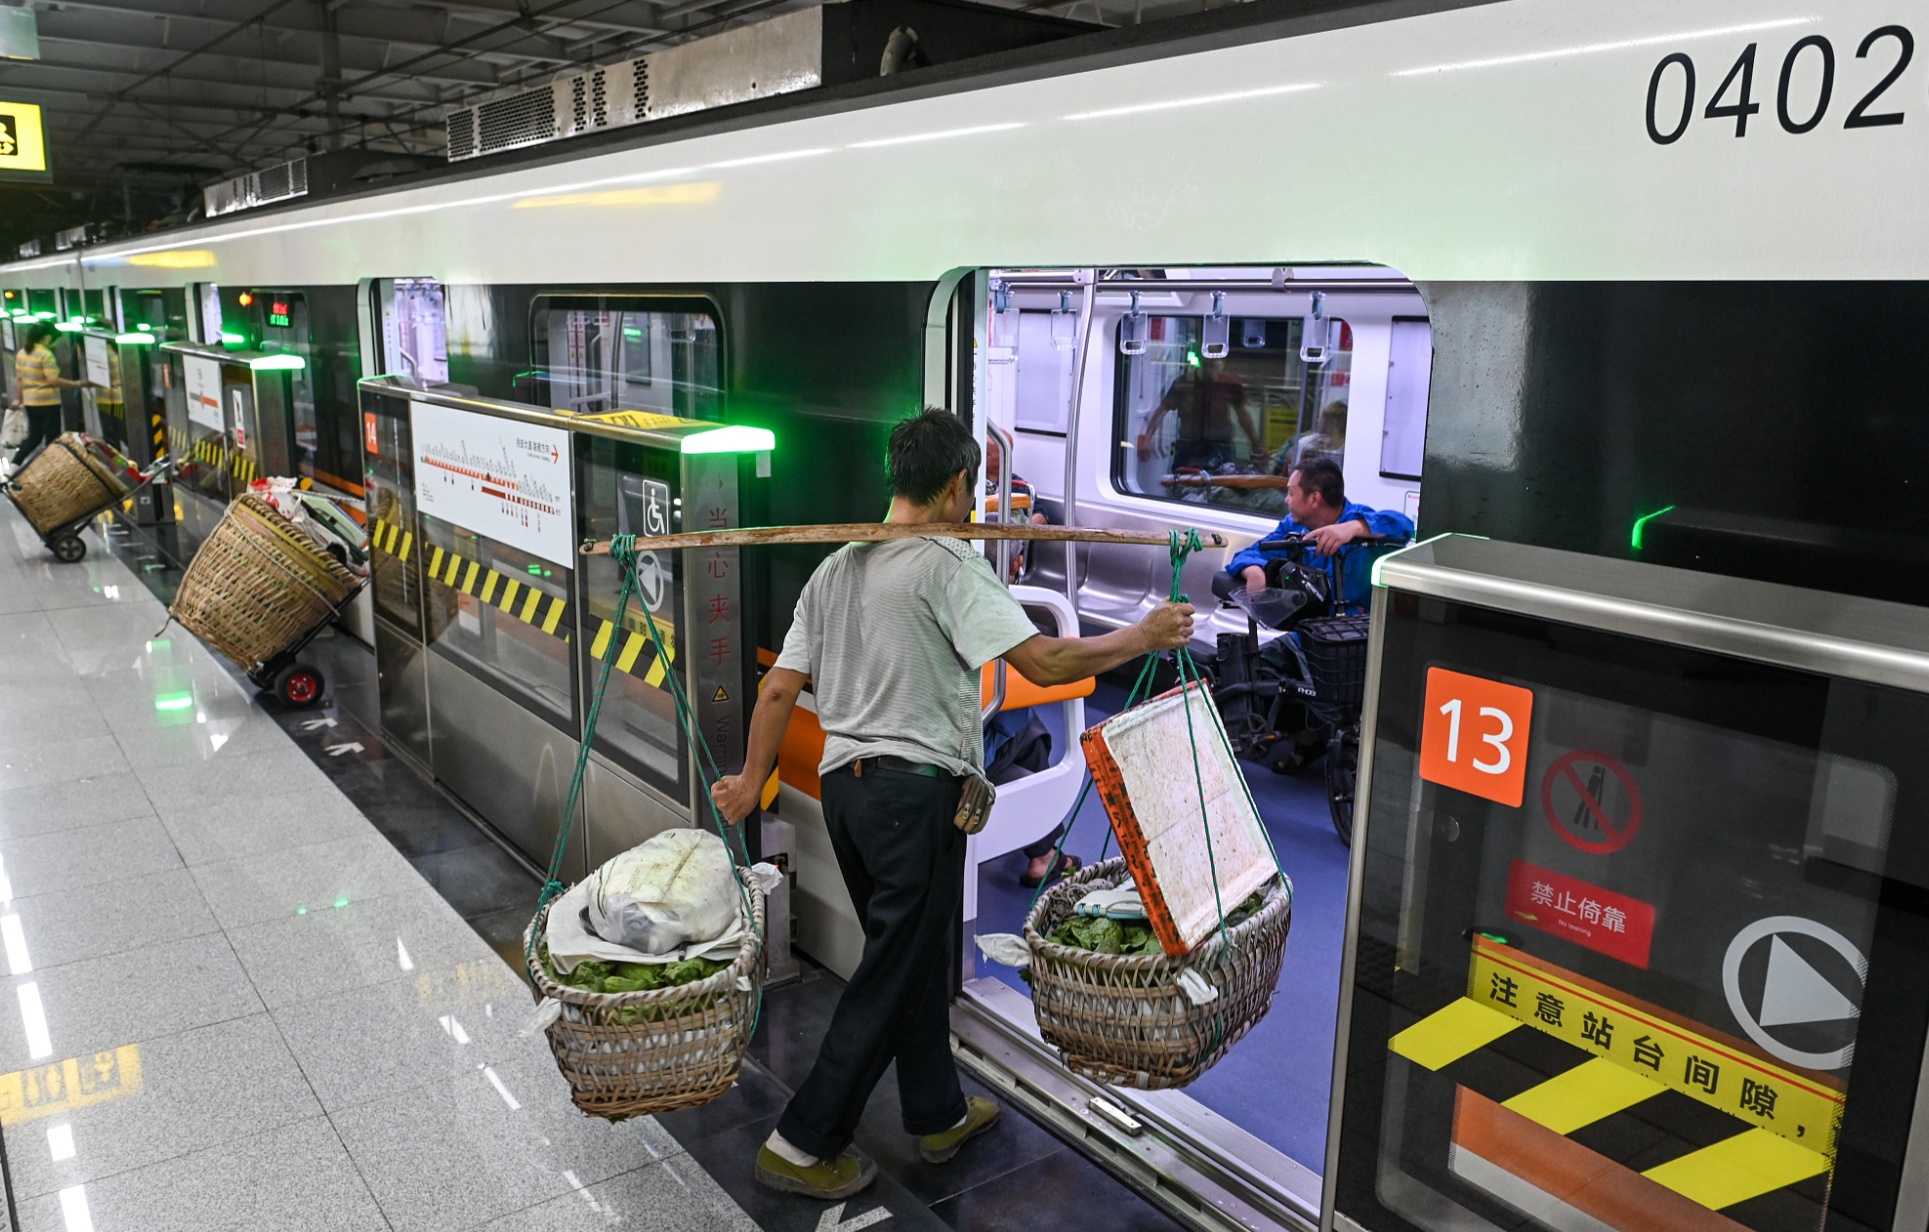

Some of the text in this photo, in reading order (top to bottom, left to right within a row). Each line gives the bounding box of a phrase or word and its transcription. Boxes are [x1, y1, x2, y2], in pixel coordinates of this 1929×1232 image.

[1646, 24, 1915, 146] 0402
[366, 422, 377, 445] 14
[708, 507, 731, 667] 当心夹手
[716, 715, 732, 777] Warnin
[1438, 698, 1515, 775] 13
[1530, 880, 1627, 934] 禁止倚靠
[1558, 919, 1592, 937] No leaning
